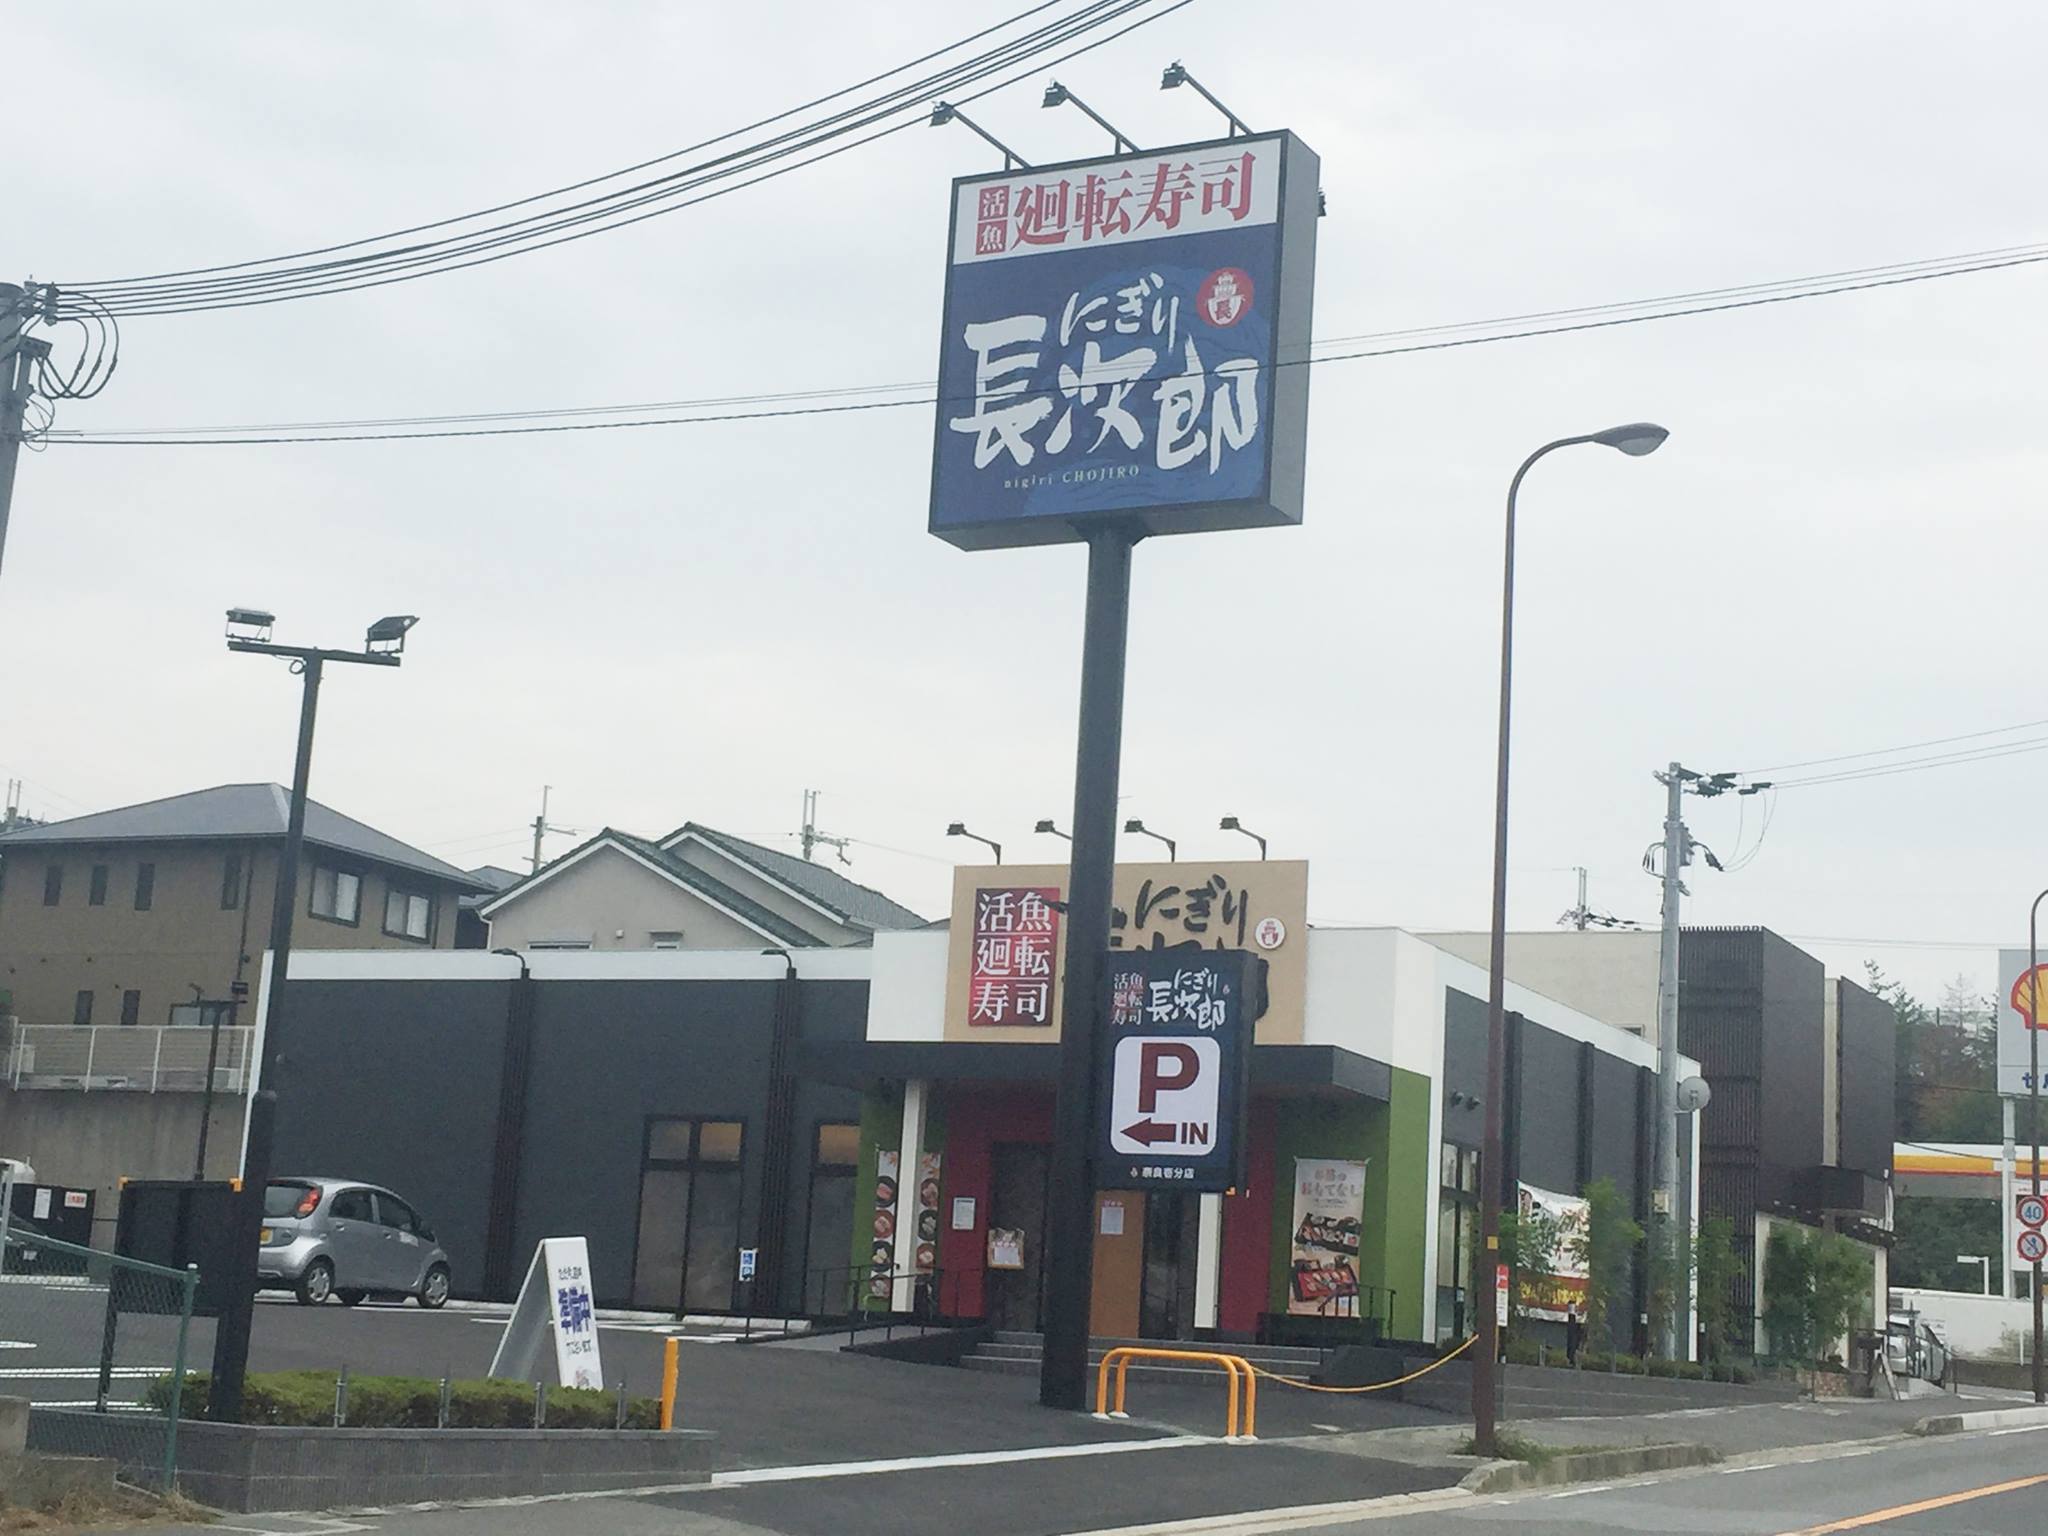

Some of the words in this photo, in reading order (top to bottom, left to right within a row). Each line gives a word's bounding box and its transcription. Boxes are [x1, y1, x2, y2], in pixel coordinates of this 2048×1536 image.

[979, 189, 1006, 252] 活魚
[1010, 151, 1256, 251] 廻転寿司
[1058, 272, 1179, 353] にぎり
[949, 314, 1260, 475] 長次郎
[1004, 474, 1053, 489] nigiri
[1062, 465, 1140, 484] CHOJIRO
[979, 891, 1052, 932] 活魚
[1135, 874, 1248, 946] にぎり
[975, 936, 1050, 977] 廻転
[973, 982, 1049, 1023] 寿司
[1174, 967, 1218, 995] にぎり
[1146, 981, 1226, 1031] 長次郎
[1138, 1042, 1200, 1113] P
[1181, 1122, 1208, 1145] IN
[2024, 1206, 2041, 1220] 40
